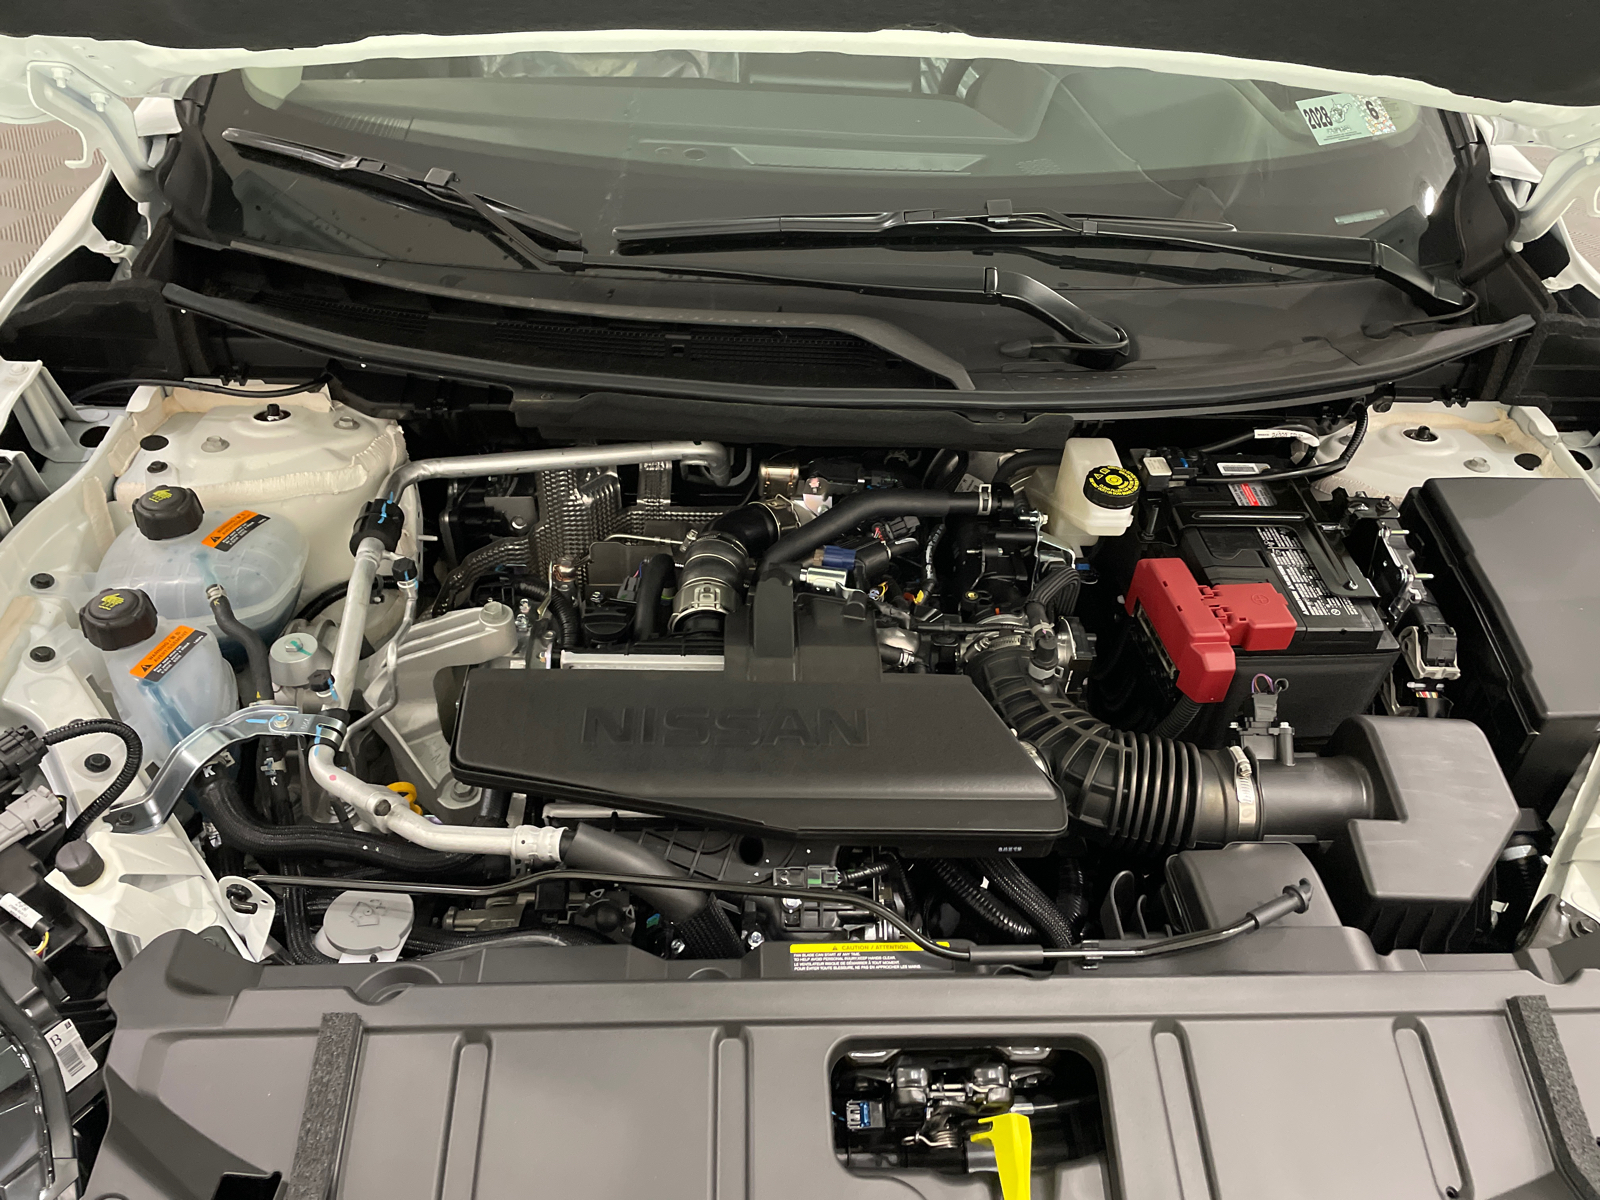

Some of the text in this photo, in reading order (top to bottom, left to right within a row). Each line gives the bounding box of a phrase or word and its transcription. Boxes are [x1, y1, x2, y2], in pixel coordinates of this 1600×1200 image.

[1303, 106, 1333, 130] 2028
[1366, 100, 1379, 120] 6
[580, 707, 869, 746] NISSAN
[202, 765, 216, 778] K
[270, 776, 278, 786] K
[50, 1034, 62, 1047] B
